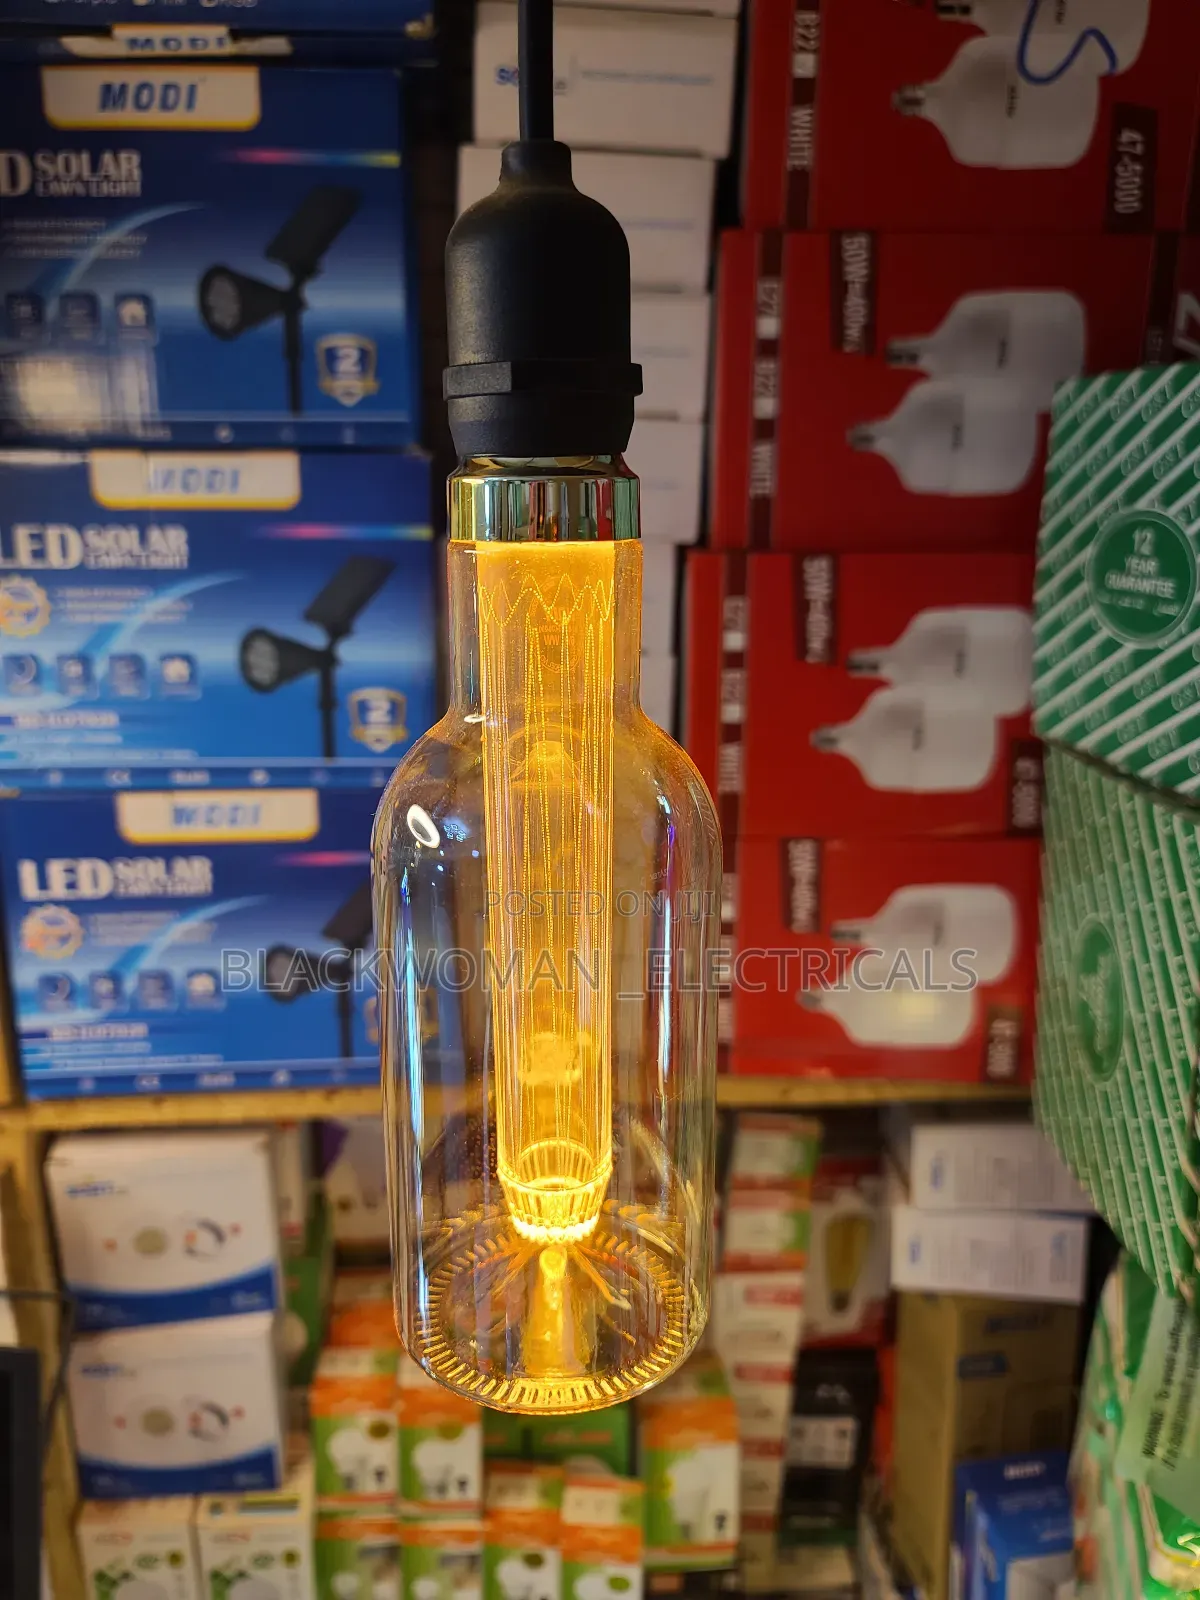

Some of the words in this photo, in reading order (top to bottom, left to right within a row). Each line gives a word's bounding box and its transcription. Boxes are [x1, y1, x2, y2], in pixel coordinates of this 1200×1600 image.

[97, 82, 198, 112] MODI
[787, 106, 814, 171] WHITE
[34, 149, 142, 182] SOLAR
[83, 522, 190, 556] SOLAR
[1132, 526, 1156, 556] 12
[1124, 553, 1160, 577] YEAR
[1104, 569, 1177, 599] GUARANTEE
[18, 857, 113, 901] LED
